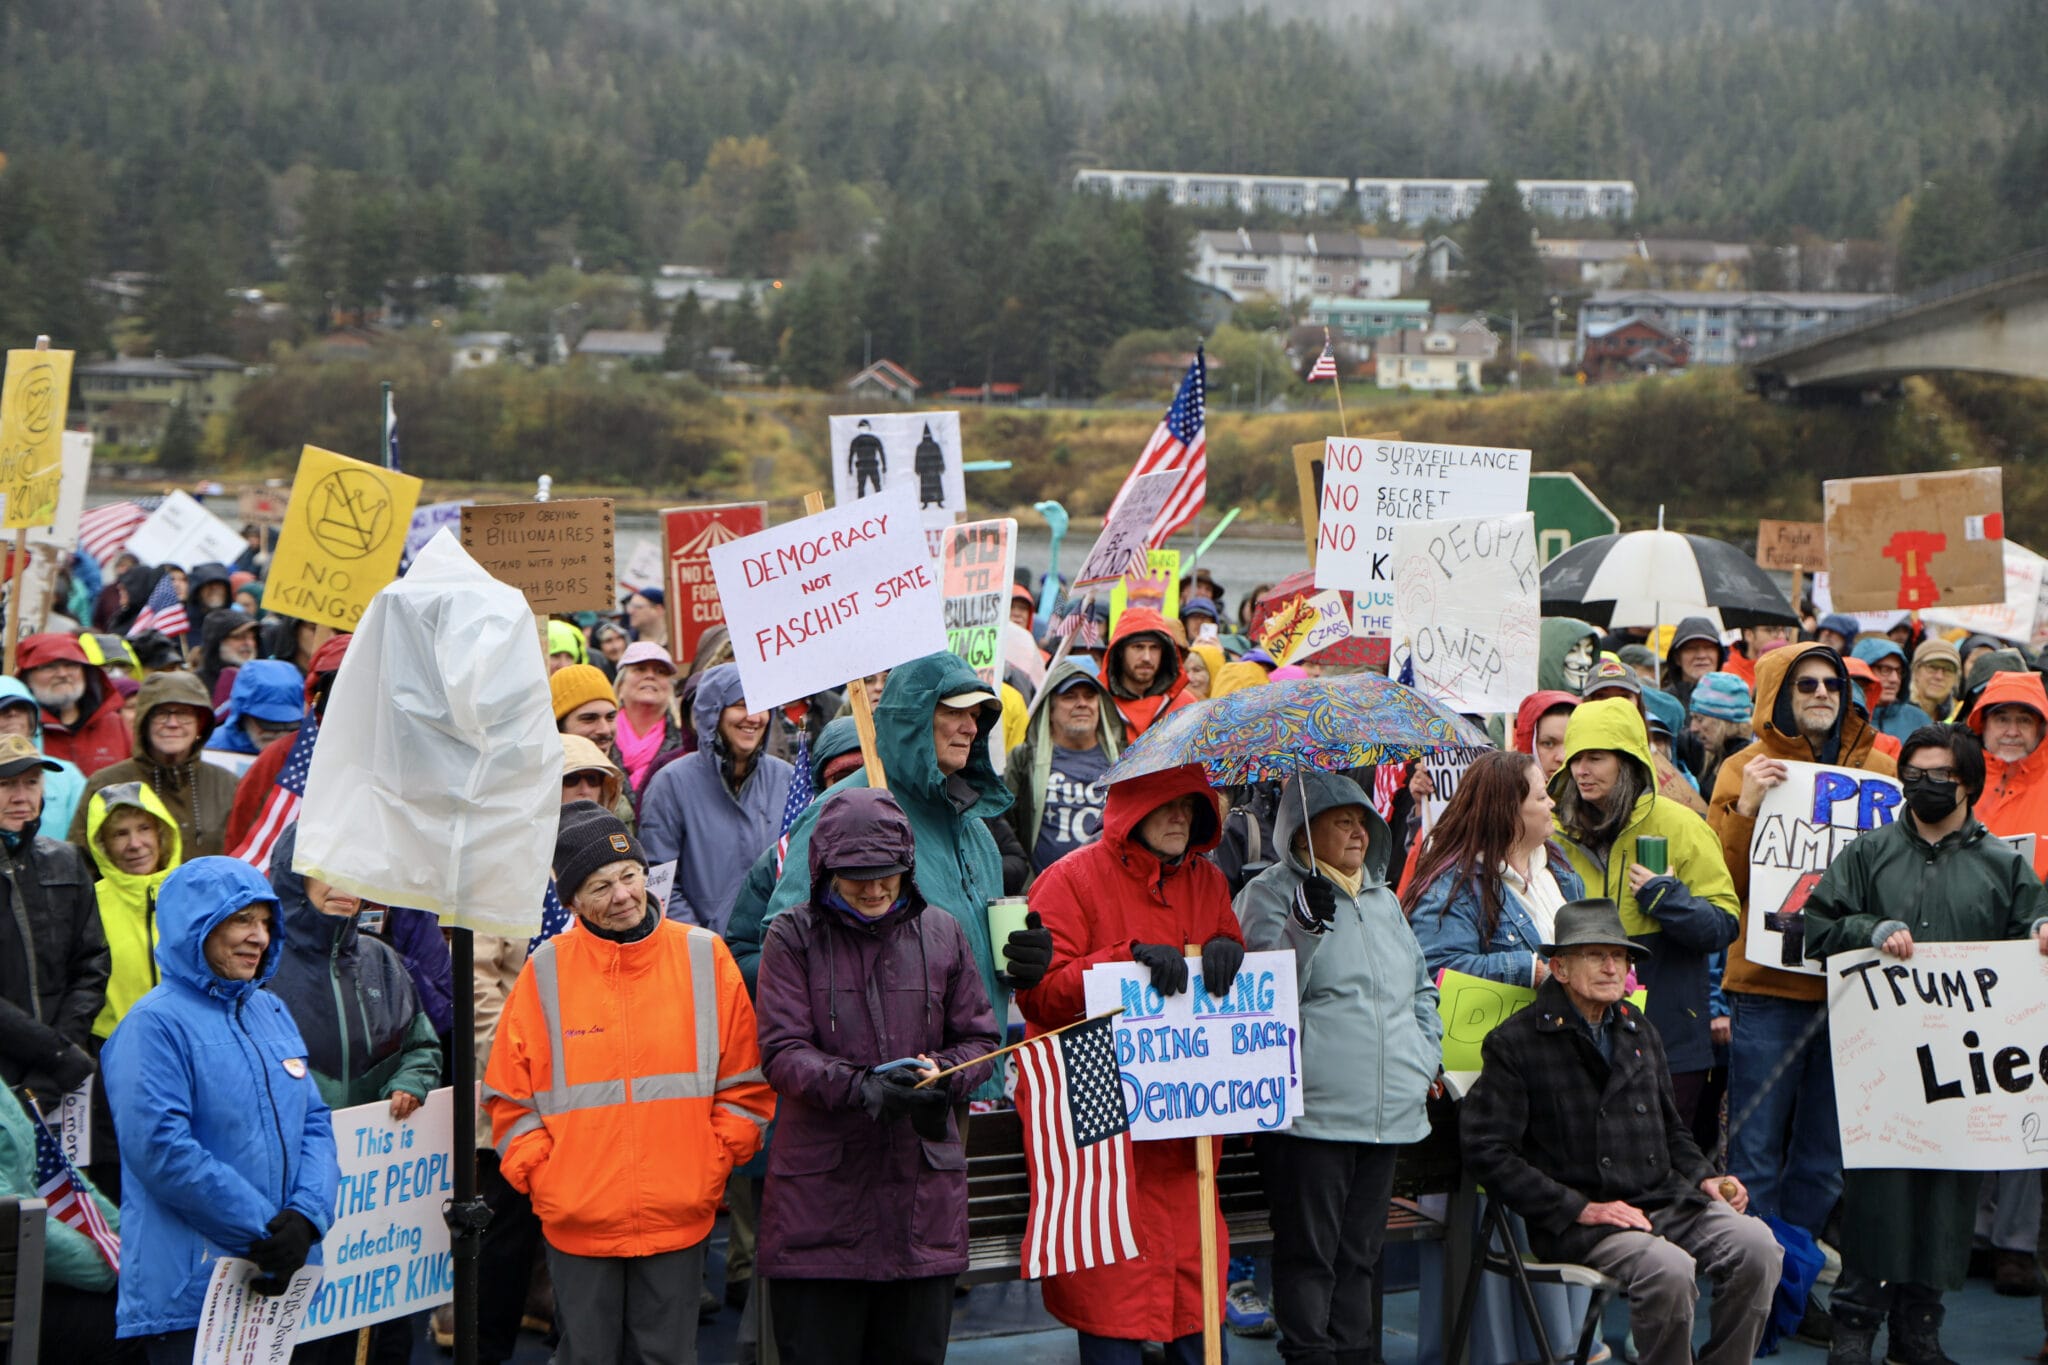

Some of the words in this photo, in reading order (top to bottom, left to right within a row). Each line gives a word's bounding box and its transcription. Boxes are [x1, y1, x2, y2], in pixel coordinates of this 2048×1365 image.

[1327, 444, 1363, 472] NO
[1376, 446, 1519, 471] SURVEILLANCE
[1391, 462, 1449, 479] STATE
[1324, 484, 1359, 512] NO
[1377, 487, 1450, 505] SECRET
[1377, 501, 1436, 520] POLICE
[492, 511, 525, 526] STOP
[539, 509, 580, 522] OBEYING
[486, 527, 594, 546] BILLIONAIRES
[742, 515, 888, 588] DEMOCRACY
[954, 522, 1001, 568] NO
[1320, 523, 1356, 551] NO
[483, 559, 521, 571] STAND
[527, 558, 553, 568] WITH
[1429, 520, 1537, 595] PEOPLE
[304, 560, 351, 593] NO
[681, 566, 701, 583] NO
[802, 574, 832, 595] NOT
[964, 568, 990, 592] TO
[272, 580, 364, 625] KINGS
[692, 586, 720, 601] FOR
[693, 603, 724, 622] CLO
[756, 592, 861, 662] FASCHIST
[874, 565, 931, 608] STATE
[944, 594, 1000, 628] BULLIES
[1320, 601, 1341, 620] NO
[1394, 628, 1502, 694] POWER
[1046, 772, 1107, 804] fuc
[1427, 769, 1453, 801] NO
[1812, 771, 1903, 831] PR
[1056, 806, 1101, 843] IC
[1121, 976, 1165, 1016] NO
[1115, 1025, 1209, 1066] BRING
[1231, 1021, 1288, 1055] BACK
[1119, 1071, 1286, 1130] Democracy
[356, 1128, 393, 1158] This
[401, 1124, 414, 1148] is
[338, 1169, 378, 1219] THE
[384, 1153, 453, 1206] PEOPL
[337, 1223, 421, 1265] defeating
[301, 1264, 400, 1330] NOTHER
[405, 1250, 454, 1303] KING
[267, 1301, 279, 1326] are
